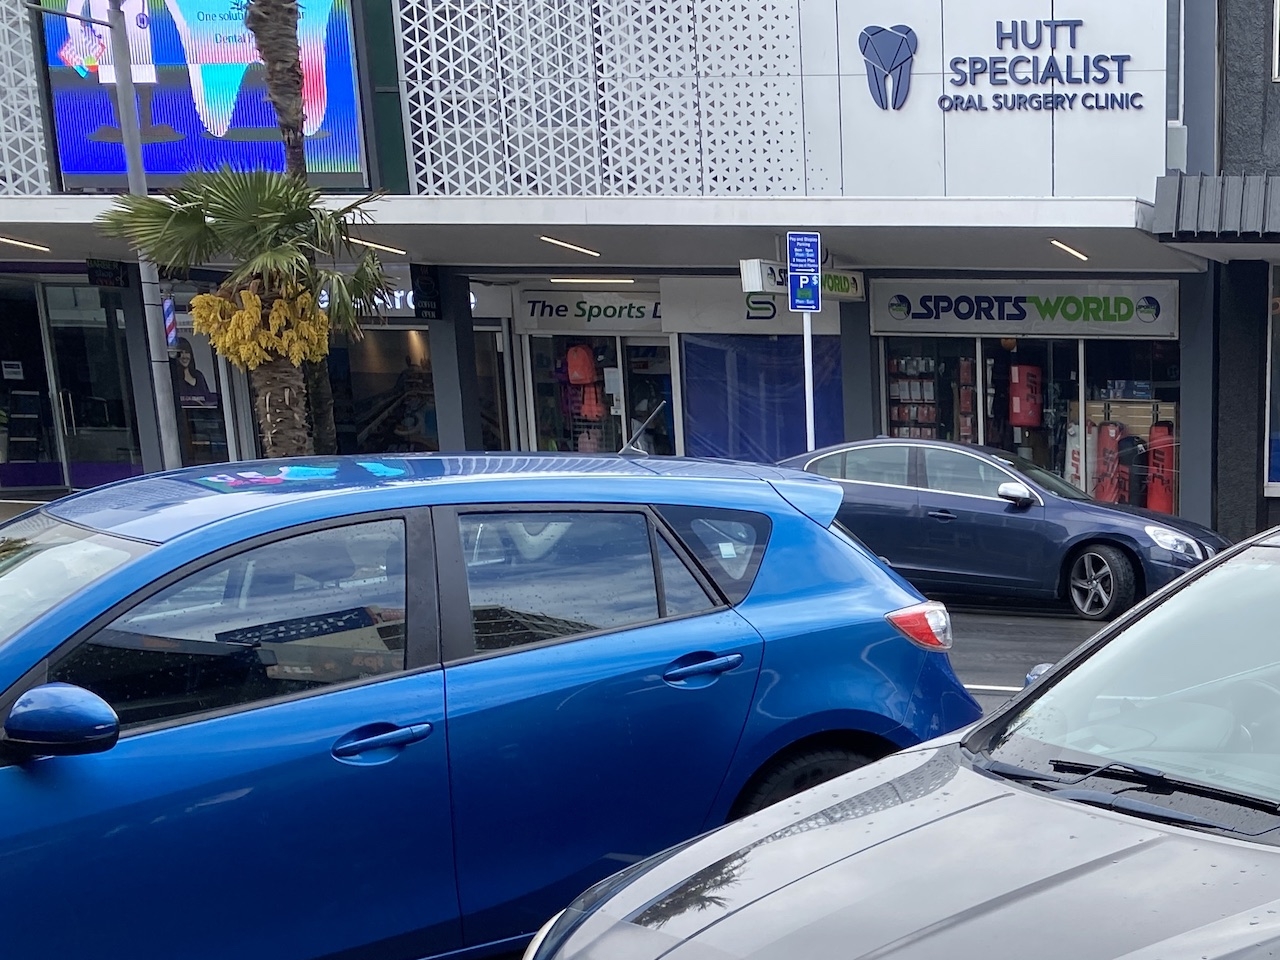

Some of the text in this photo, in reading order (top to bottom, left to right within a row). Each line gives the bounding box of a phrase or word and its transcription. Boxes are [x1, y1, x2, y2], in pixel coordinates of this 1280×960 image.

[197, 11, 217, 22] One
[215, 33, 246, 44] Dental
[996, 19, 1083, 50] HUTT
[949, 54, 1131, 87] SPECIALIST
[938, 92, 1143, 112] ORAL SURGERY CLINIC
[800, 275, 809, 288] P
[812, 276, 819, 285] $
[527, 300, 569, 318] The
[575, 301, 647, 322] Sports
